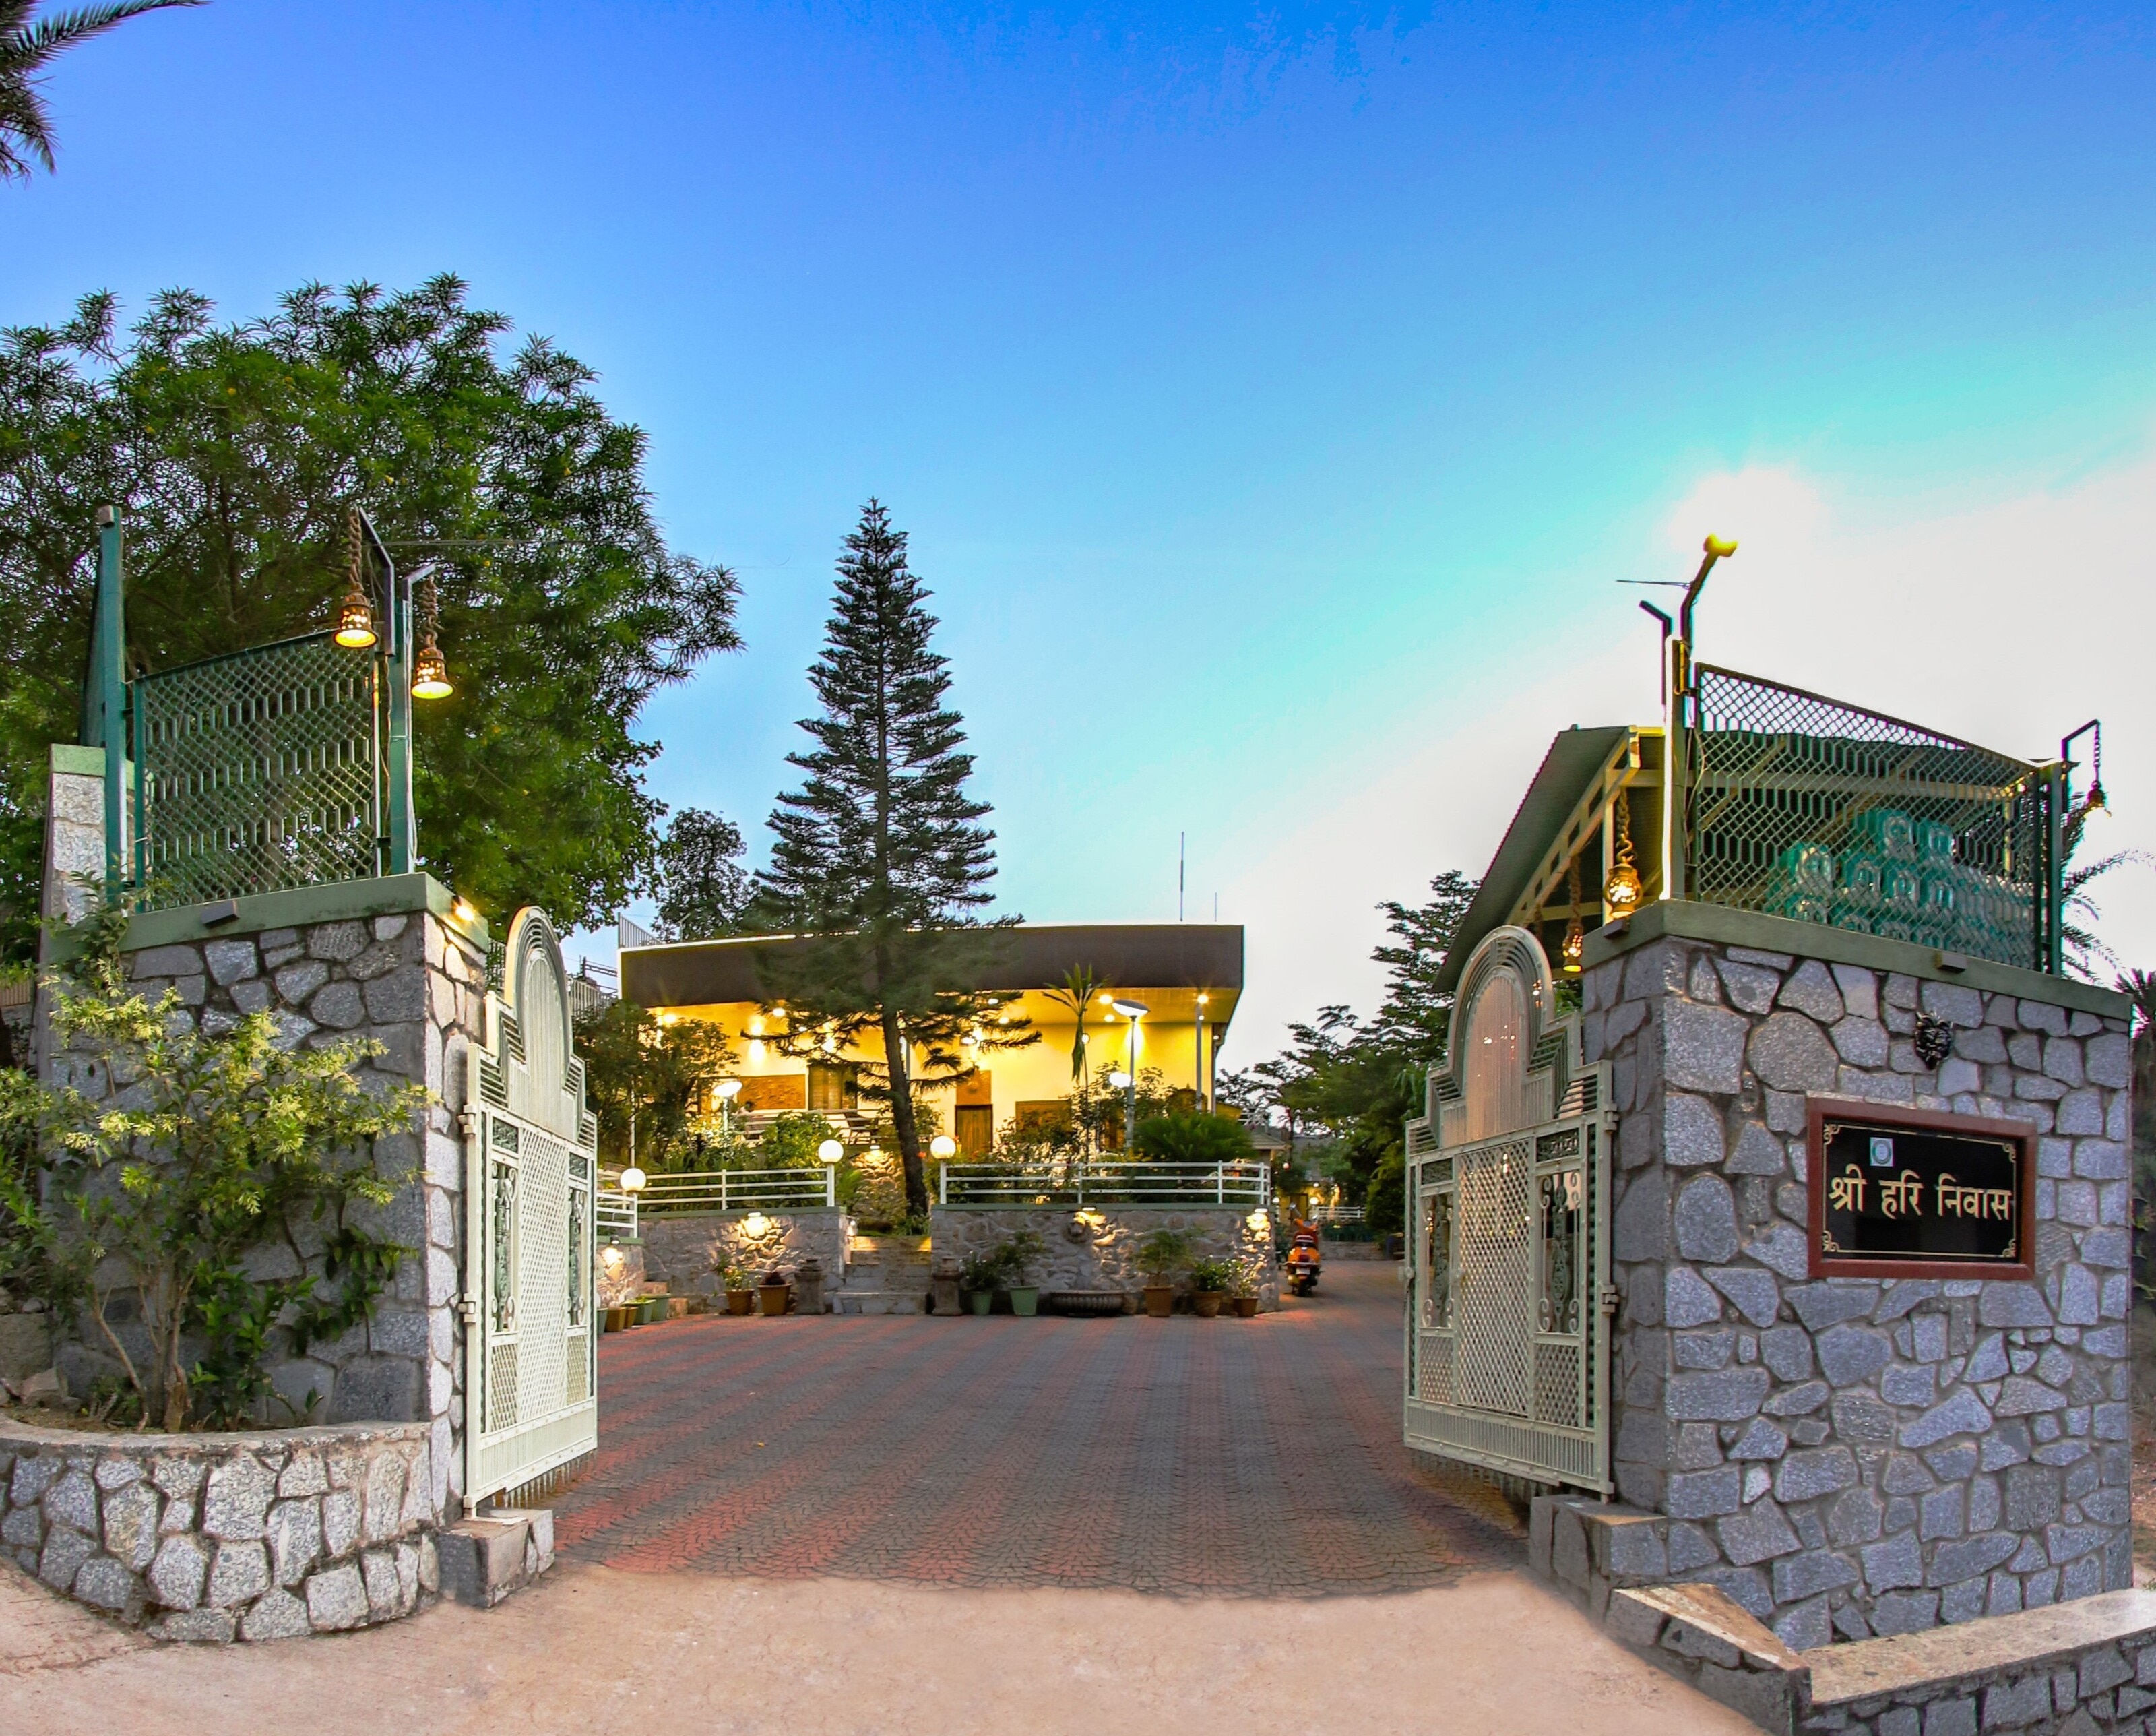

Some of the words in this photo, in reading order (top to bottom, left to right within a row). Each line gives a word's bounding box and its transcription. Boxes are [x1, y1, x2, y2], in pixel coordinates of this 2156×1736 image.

[1829, 1163, 1867, 1212] श्री
[1879, 1169, 1923, 1219] हरि
[1936, 1173, 2012, 1220] निवास
